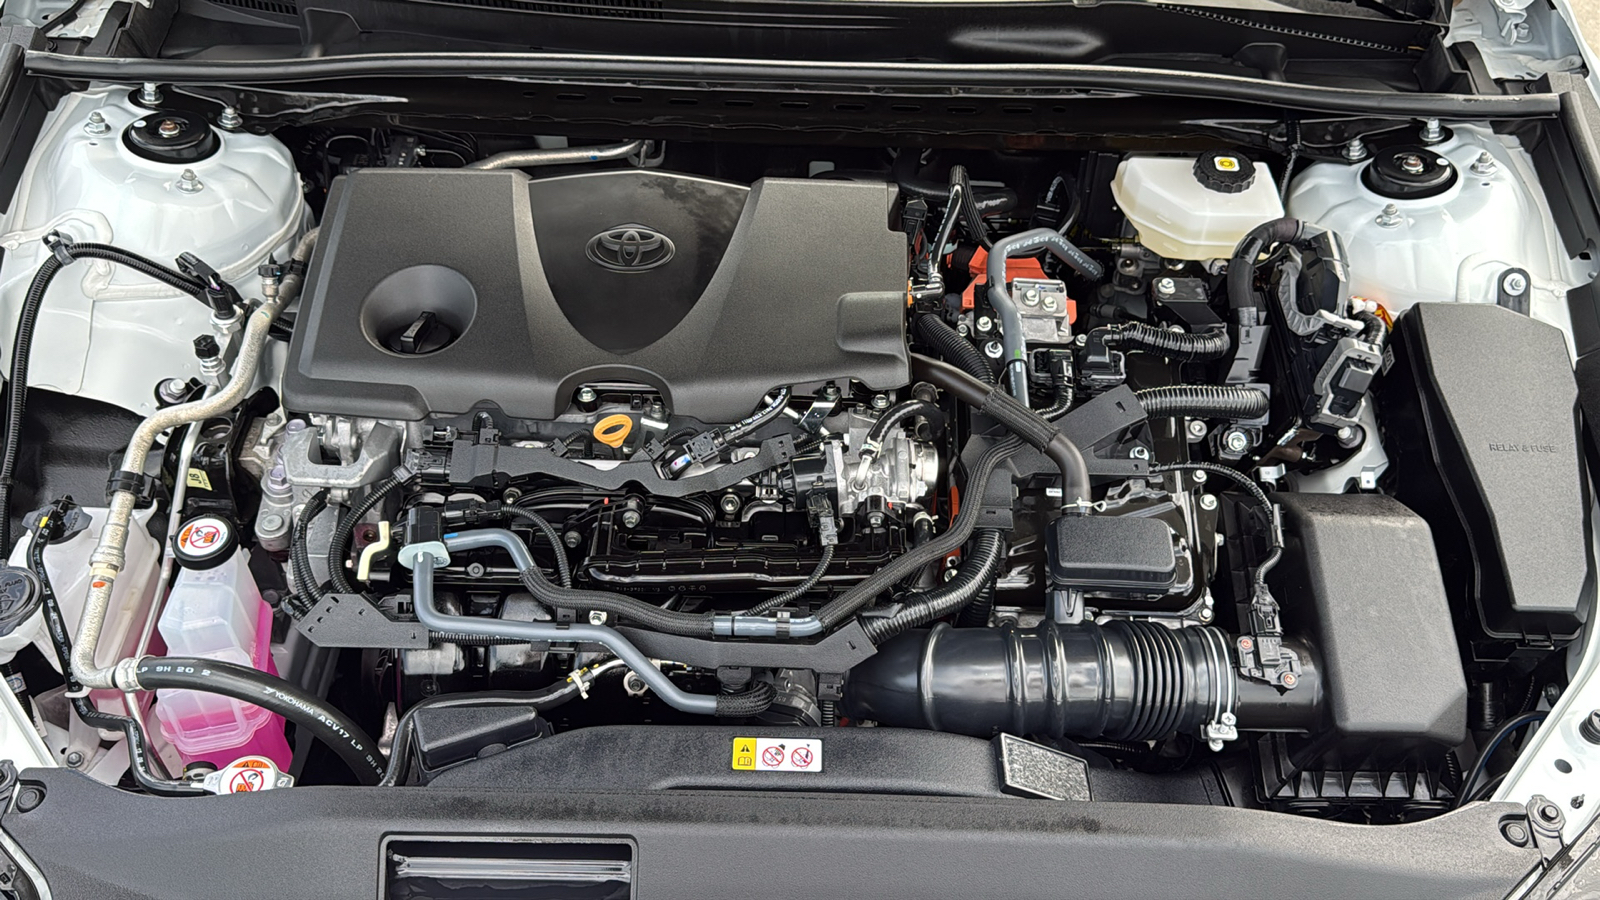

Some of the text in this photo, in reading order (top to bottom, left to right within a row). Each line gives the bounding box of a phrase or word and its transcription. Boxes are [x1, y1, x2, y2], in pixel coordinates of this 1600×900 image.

[1488, 443, 1556, 453] RELAY & FUSE
[155, 665, 172, 673] 9H
[176, 666, 195, 674] 20
[200, 669, 212, 677] 2
[274, 690, 315, 715] YOKOHAMA
[317, 714, 351, 739] ACV17
[350, 739, 364, 752] LP
